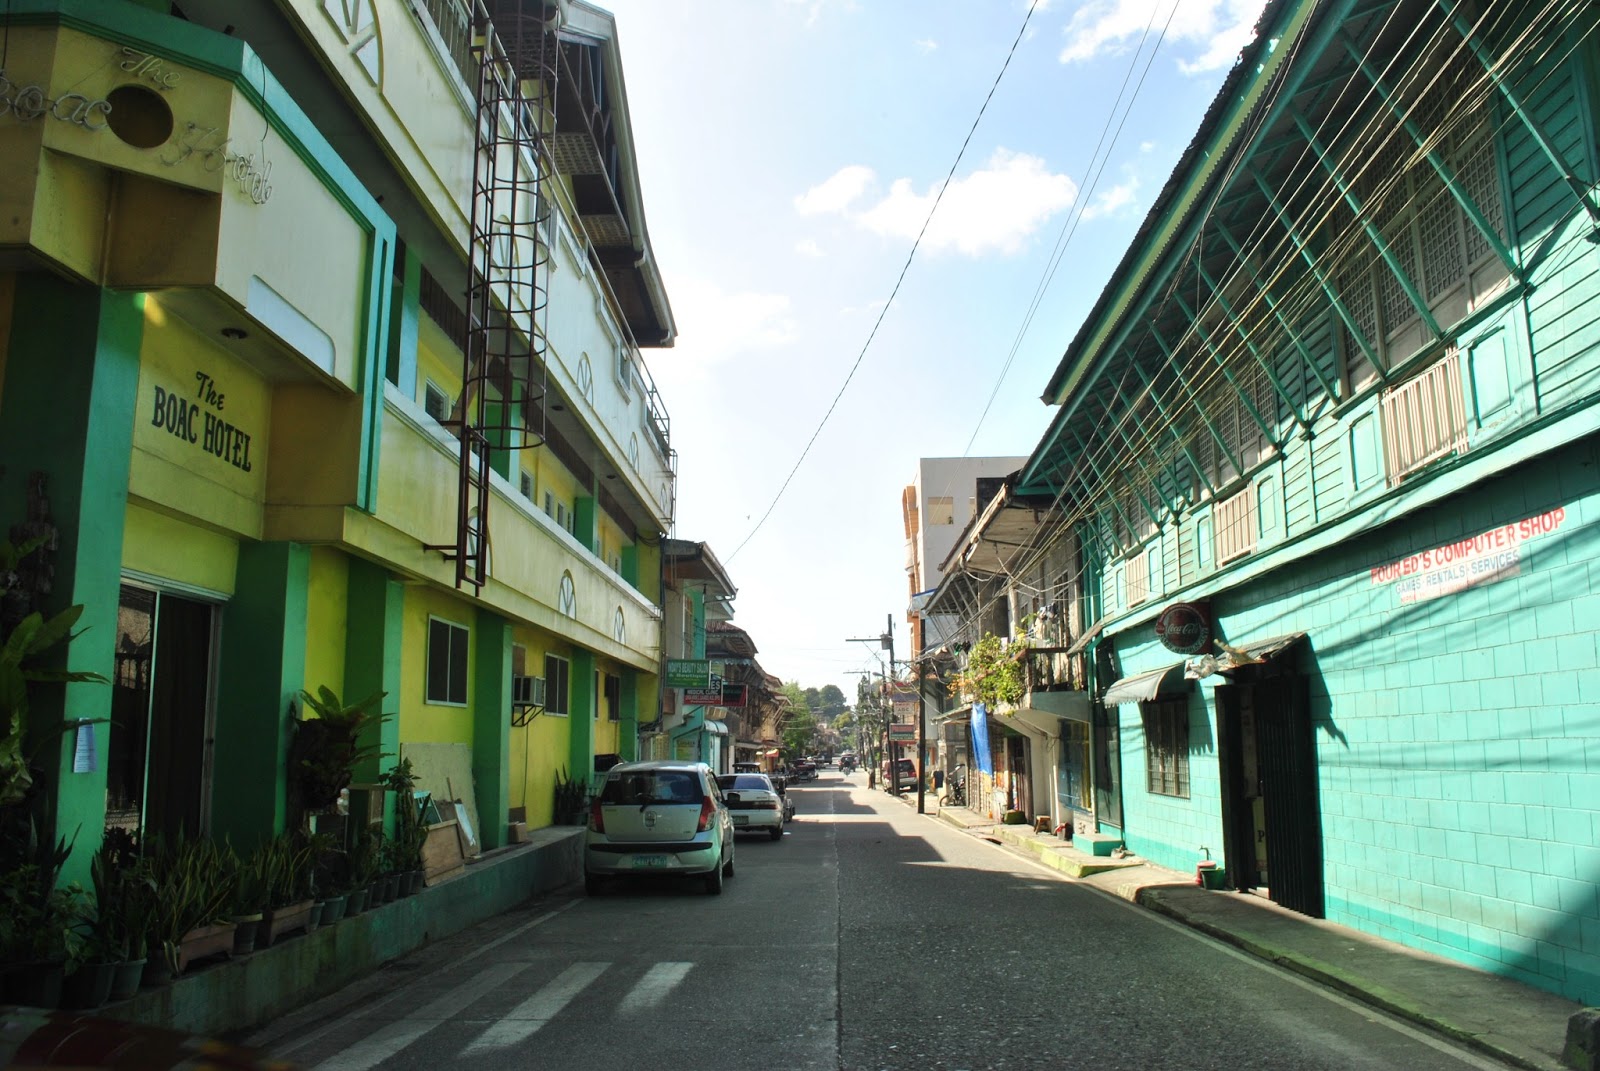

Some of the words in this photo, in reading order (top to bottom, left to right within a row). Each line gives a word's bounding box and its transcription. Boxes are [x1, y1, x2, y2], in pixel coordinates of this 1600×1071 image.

[196, 371, 225, 411] The
[151, 385, 199, 444] BOAC
[202, 411, 252, 473] HOTEL
[1435, 523, 1516, 566] COMPUTER
[1519, 506, 1566, 540] SHOP
[1395, 577, 1421, 595] GAMES
[1426, 564, 1466, 587] RENTALS
[1472, 550, 1520, 574] SERVICES
